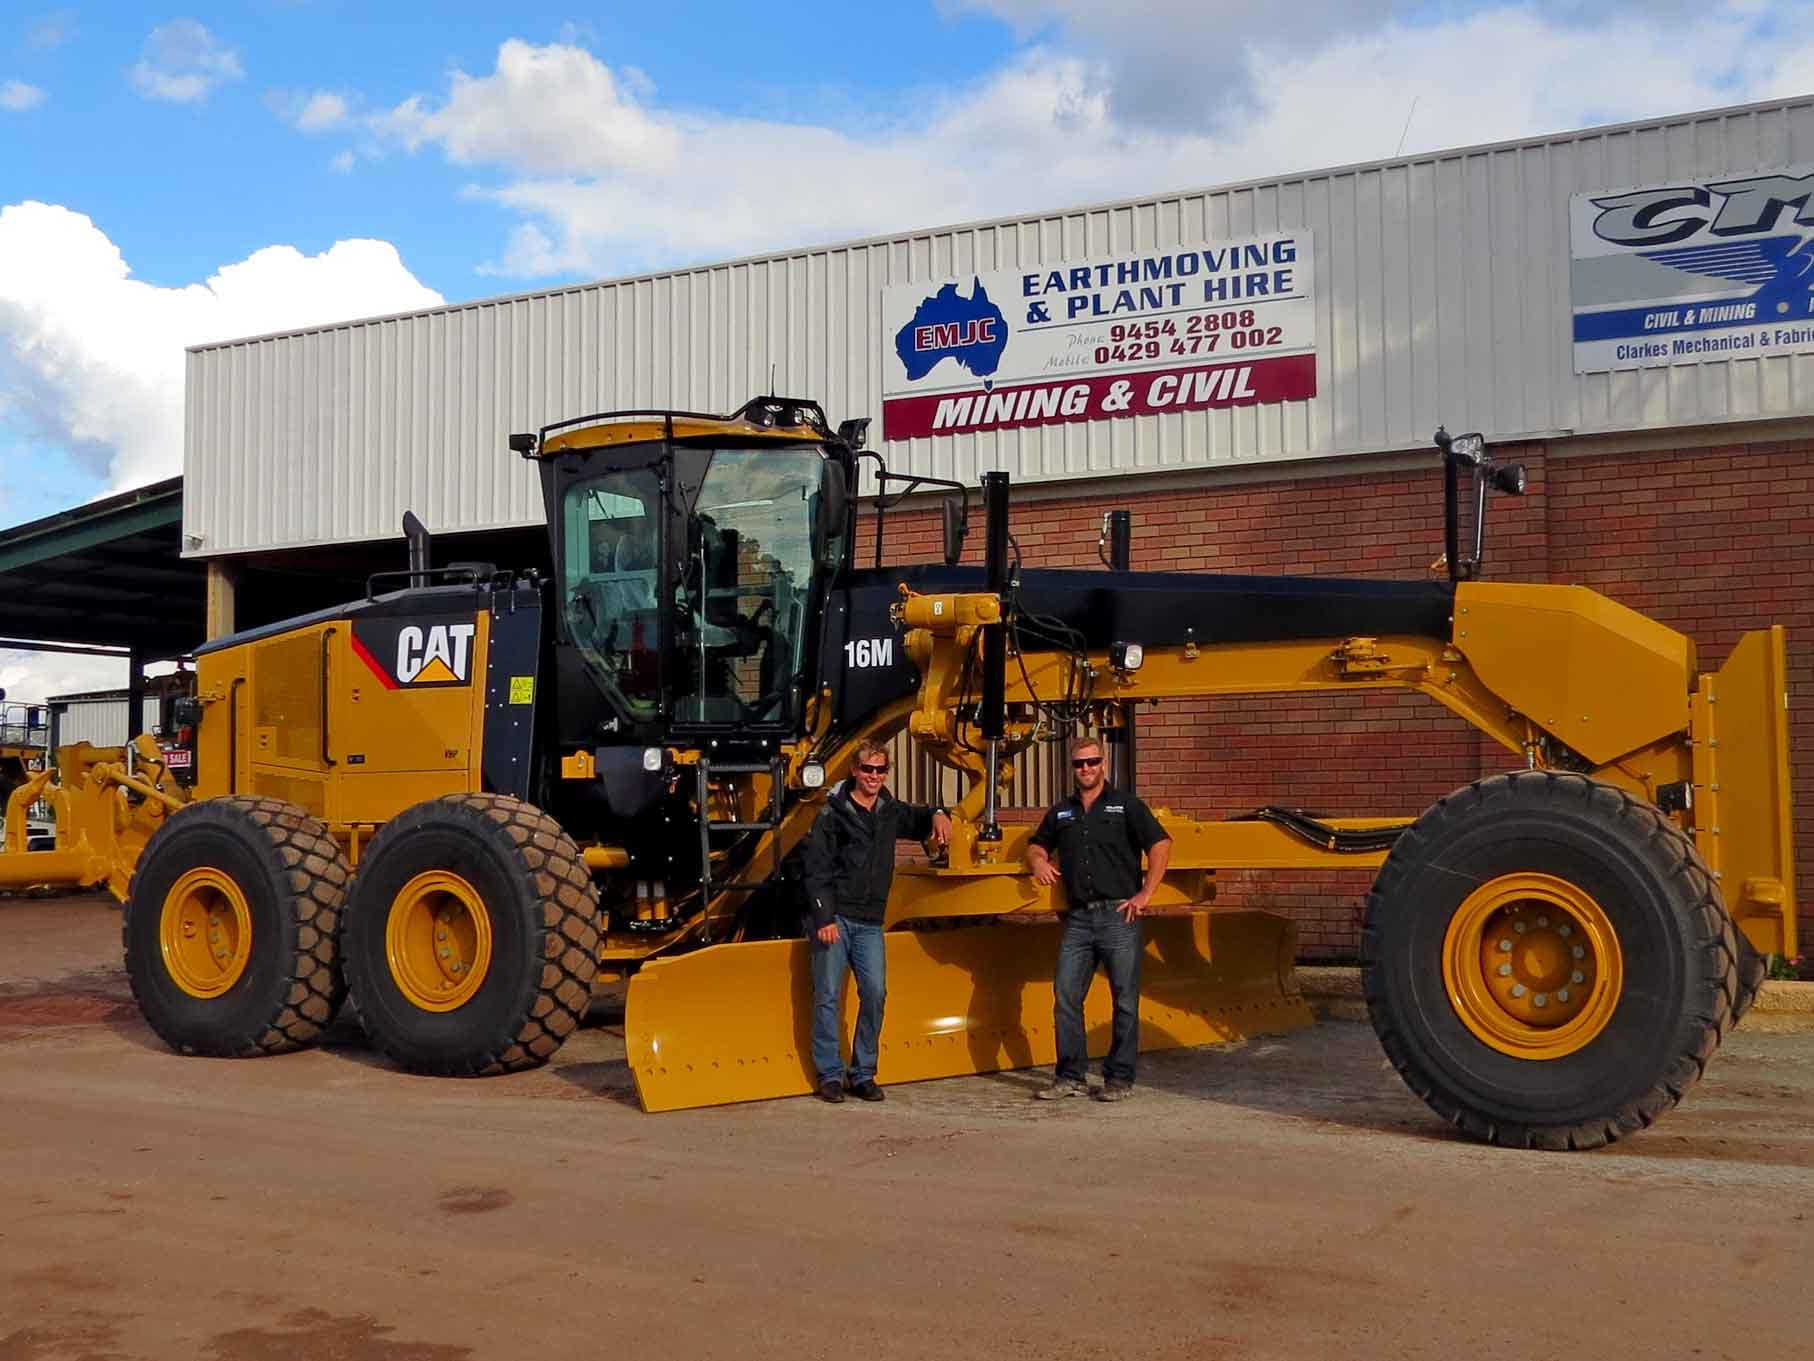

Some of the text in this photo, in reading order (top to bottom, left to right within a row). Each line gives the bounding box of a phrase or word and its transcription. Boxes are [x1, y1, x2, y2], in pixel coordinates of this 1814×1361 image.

[1023, 239, 1296, 297] EARTHMOVING
[1026, 268, 1294, 324] & PLANT HIRE
[914, 316, 996, 352] EMJC
[1110, 318, 1177, 343] 9454
[1186, 309, 1255, 334] 2808
[1643, 303, 1757, 330] CIVIL & MINING
[1094, 341, 1160, 364] 0429
[1170, 333, 1220, 356] 477
[1231, 327, 1283, 349] 002
[1616, 342, 1668, 361] Clarkes
[1672, 333, 1755, 355] Mechanical
[1760, 331, 1770, 347] &
[931, 366, 1257, 430] MINING & CIVIL
[396, 623, 475, 683] CAT
[844, 638, 894, 668] 16M
[169, 753, 187, 764] SALE
